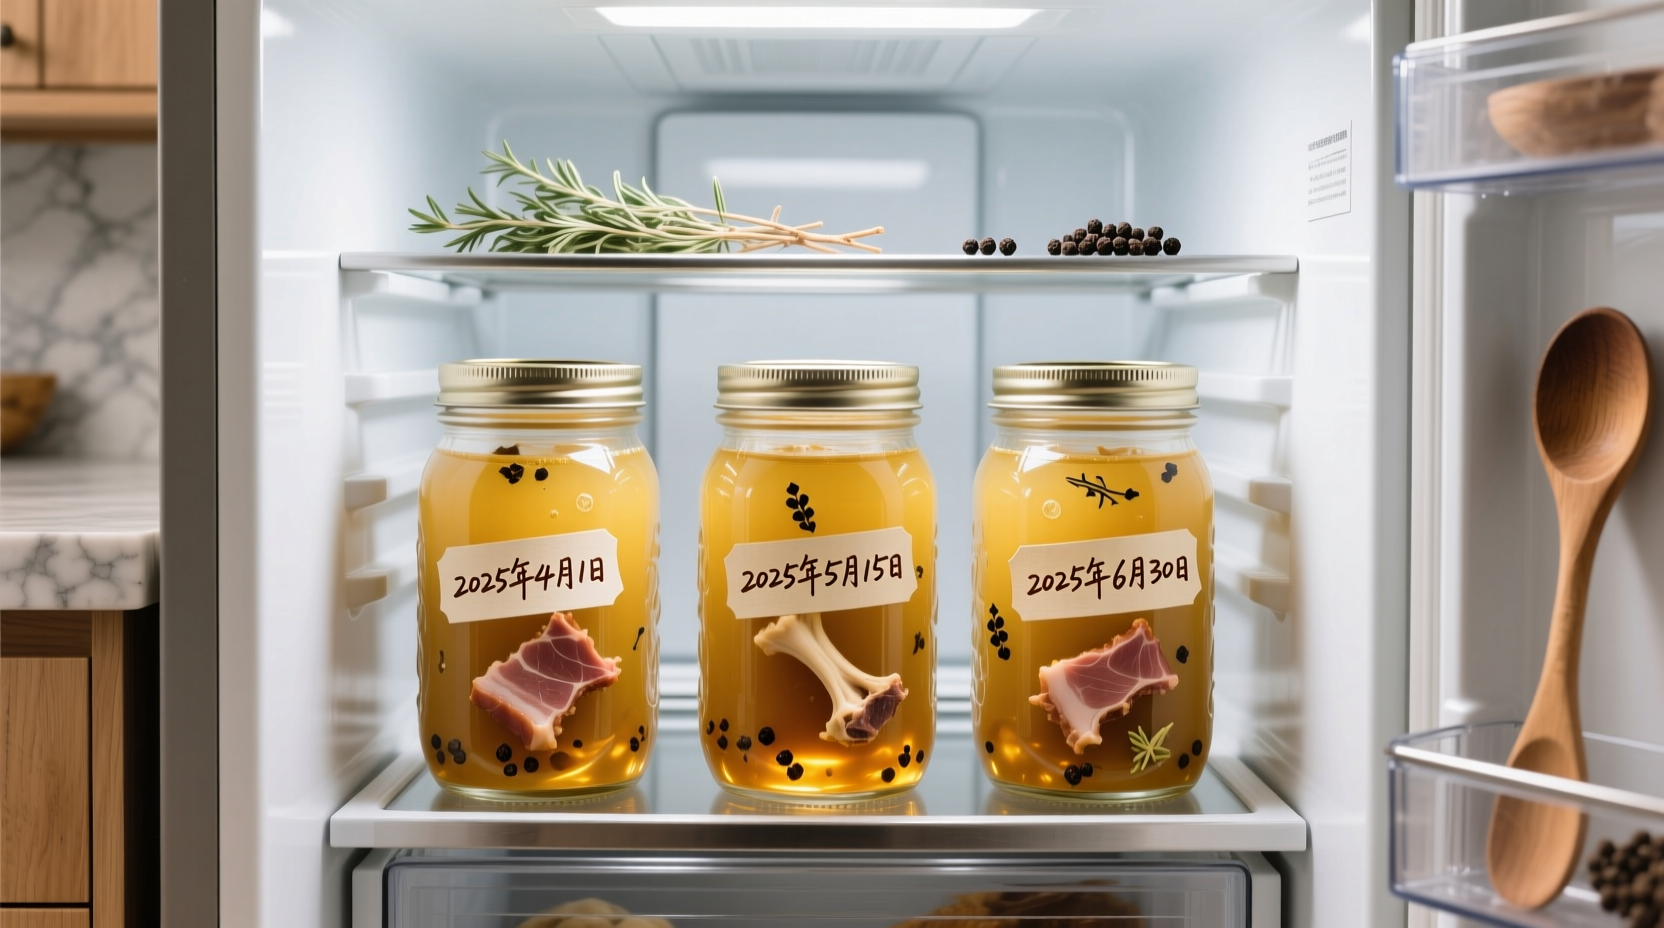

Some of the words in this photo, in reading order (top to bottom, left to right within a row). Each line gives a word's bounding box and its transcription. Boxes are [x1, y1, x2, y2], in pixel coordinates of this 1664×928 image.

[453, 556, 604, 601] 2025年4月1日
[740, 553, 903, 597] 2025年5月15日
[1026, 556, 1189, 600] 2025年6月30日
